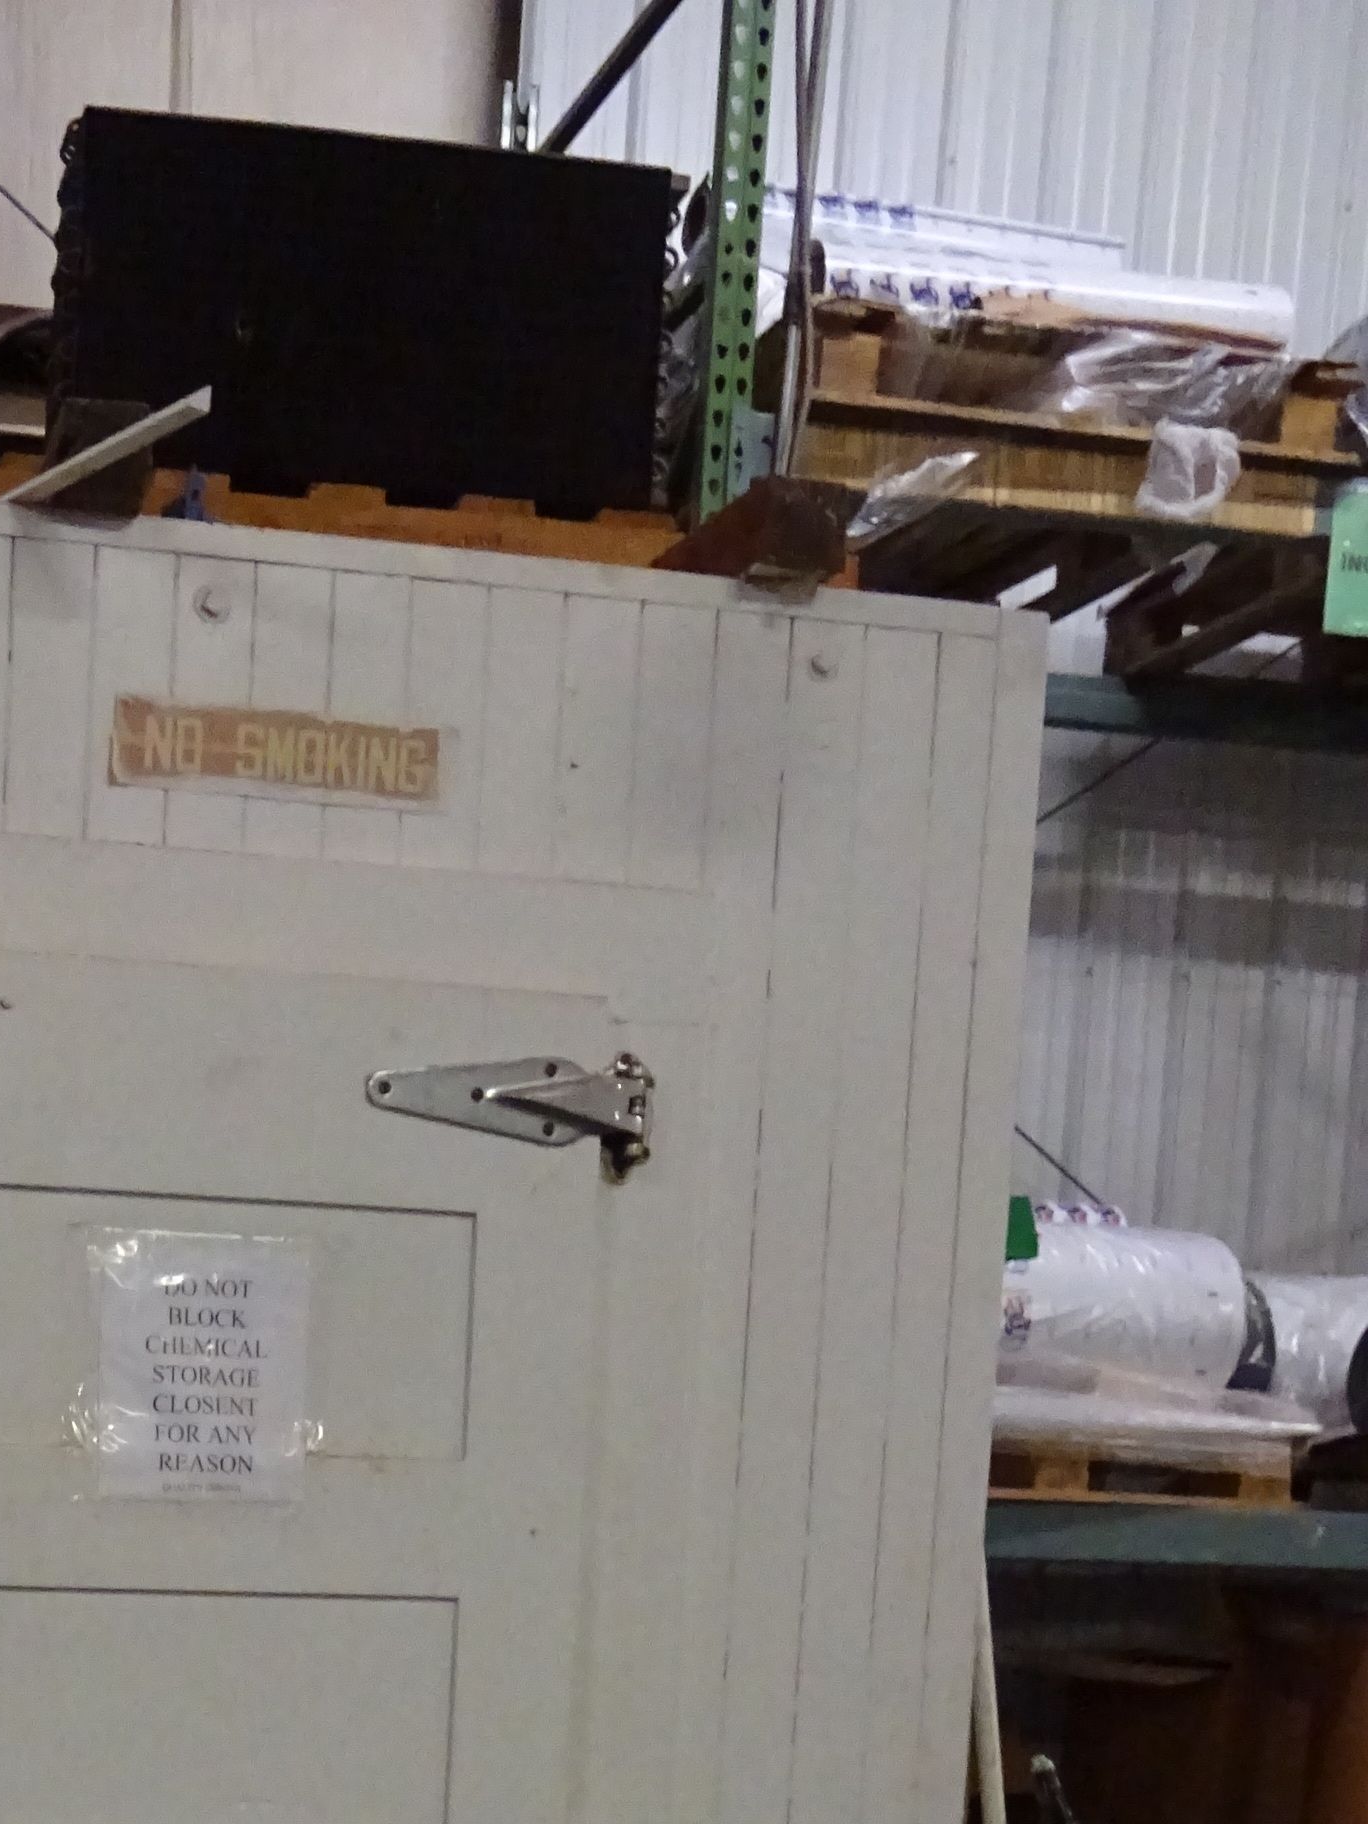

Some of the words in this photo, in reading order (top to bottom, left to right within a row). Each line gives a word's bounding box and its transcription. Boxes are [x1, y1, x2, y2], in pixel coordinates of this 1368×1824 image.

[143, 713, 203, 773] NO
[234, 721, 428, 794] SMOKING
[163, 1277, 197, 1298] DO
[204, 1278, 254, 1299] NOT
[168, 1305, 247, 1329] BLOCK
[144, 1334, 268, 1359] CHEMICAL
[152, 1364, 261, 1388] STORAGE
[154, 1423, 201, 1443] FOR
[208, 1424, 257, 1445] ANY
[158, 1452, 254, 1475] REASON
